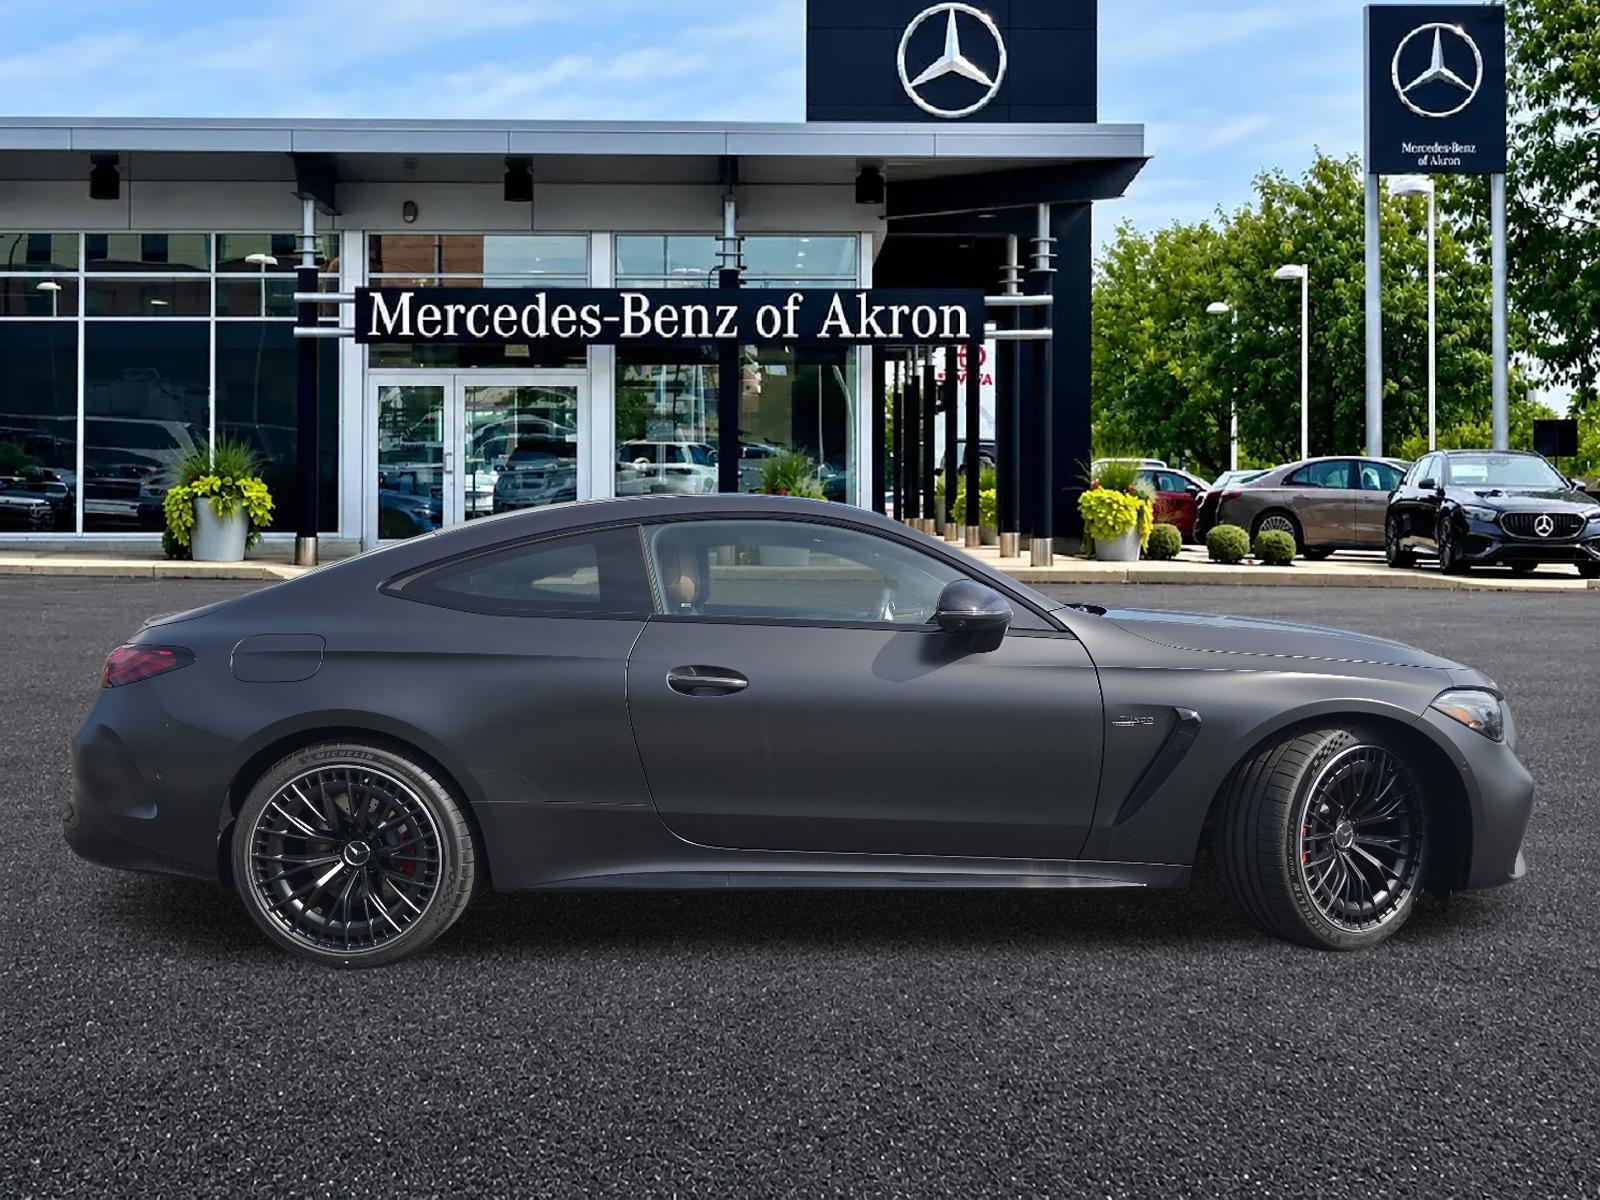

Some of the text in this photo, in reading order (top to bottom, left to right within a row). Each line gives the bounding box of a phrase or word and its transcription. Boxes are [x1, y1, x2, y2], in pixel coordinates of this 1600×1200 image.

[1401, 141, 1477, 154] Mercedes-Benz
[1417, 154, 1461, 166] of Akron
[367, 291, 970, 339] Mercedes-Benz of Akron
